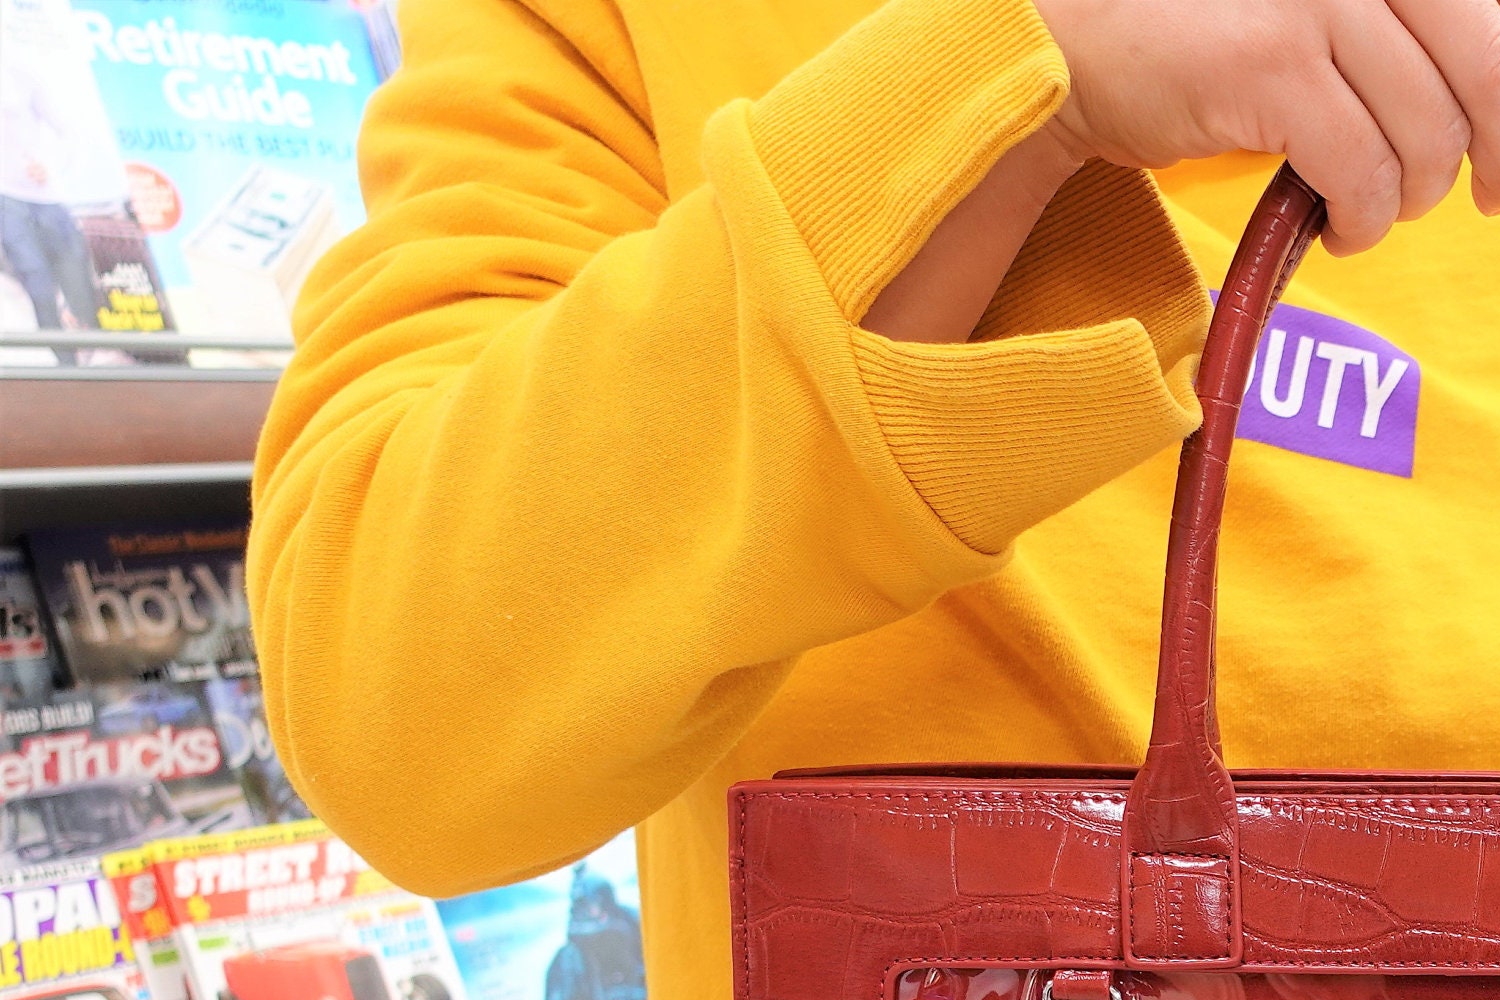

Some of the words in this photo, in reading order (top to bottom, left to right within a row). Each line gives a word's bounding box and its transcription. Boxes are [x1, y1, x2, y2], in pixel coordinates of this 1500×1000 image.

[78, 9, 357, 85] Retirement
[162, 68, 313, 128] Guide
[1244, 328, 1409, 438] UTY
[173, 844, 318, 898] STREET
